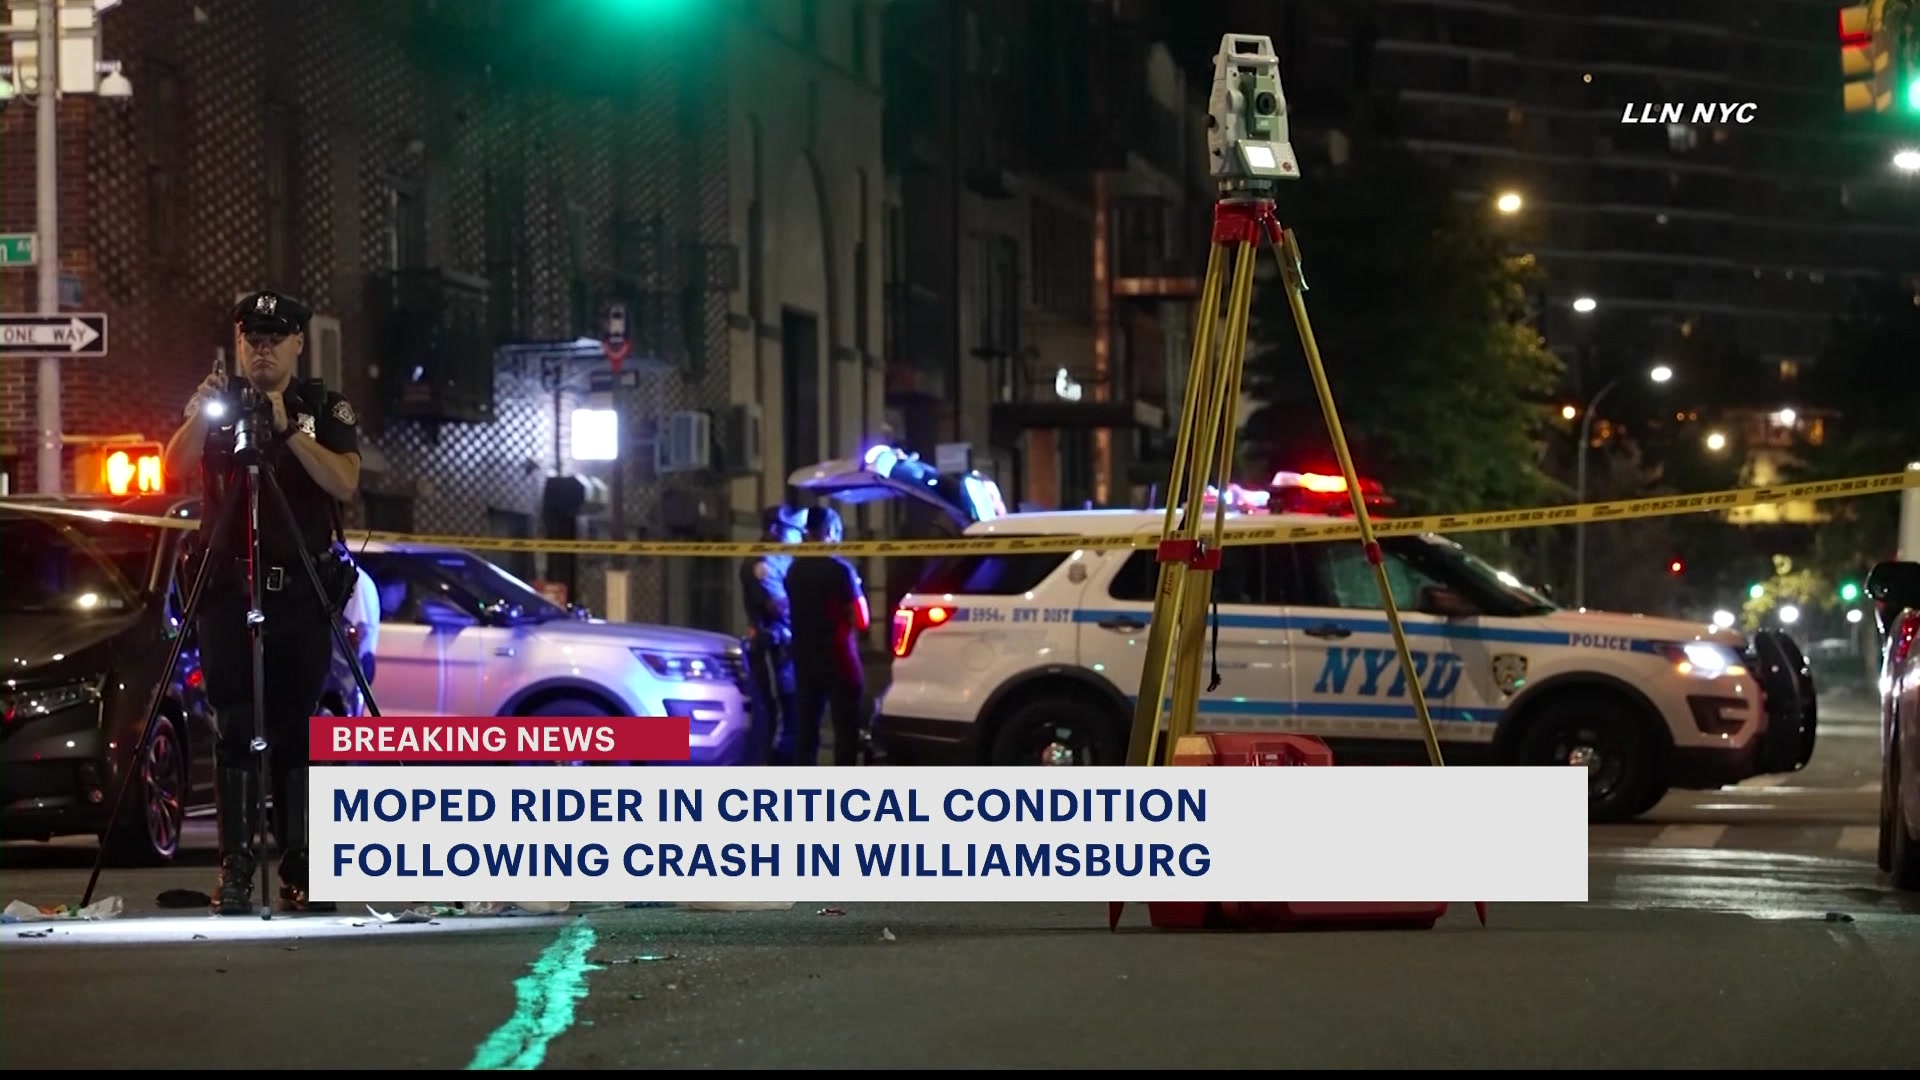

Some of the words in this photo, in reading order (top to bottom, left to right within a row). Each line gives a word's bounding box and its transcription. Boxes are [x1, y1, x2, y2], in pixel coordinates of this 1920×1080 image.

[4, 328, 35, 342] ONE
[53, 328, 87, 342] WAY
[1012, 608, 1038, 622] HWY
[1043, 608, 1070, 623] DIST
[1571, 633, 1630, 651] POLICE
[1313, 646, 1464, 699] NYPD
